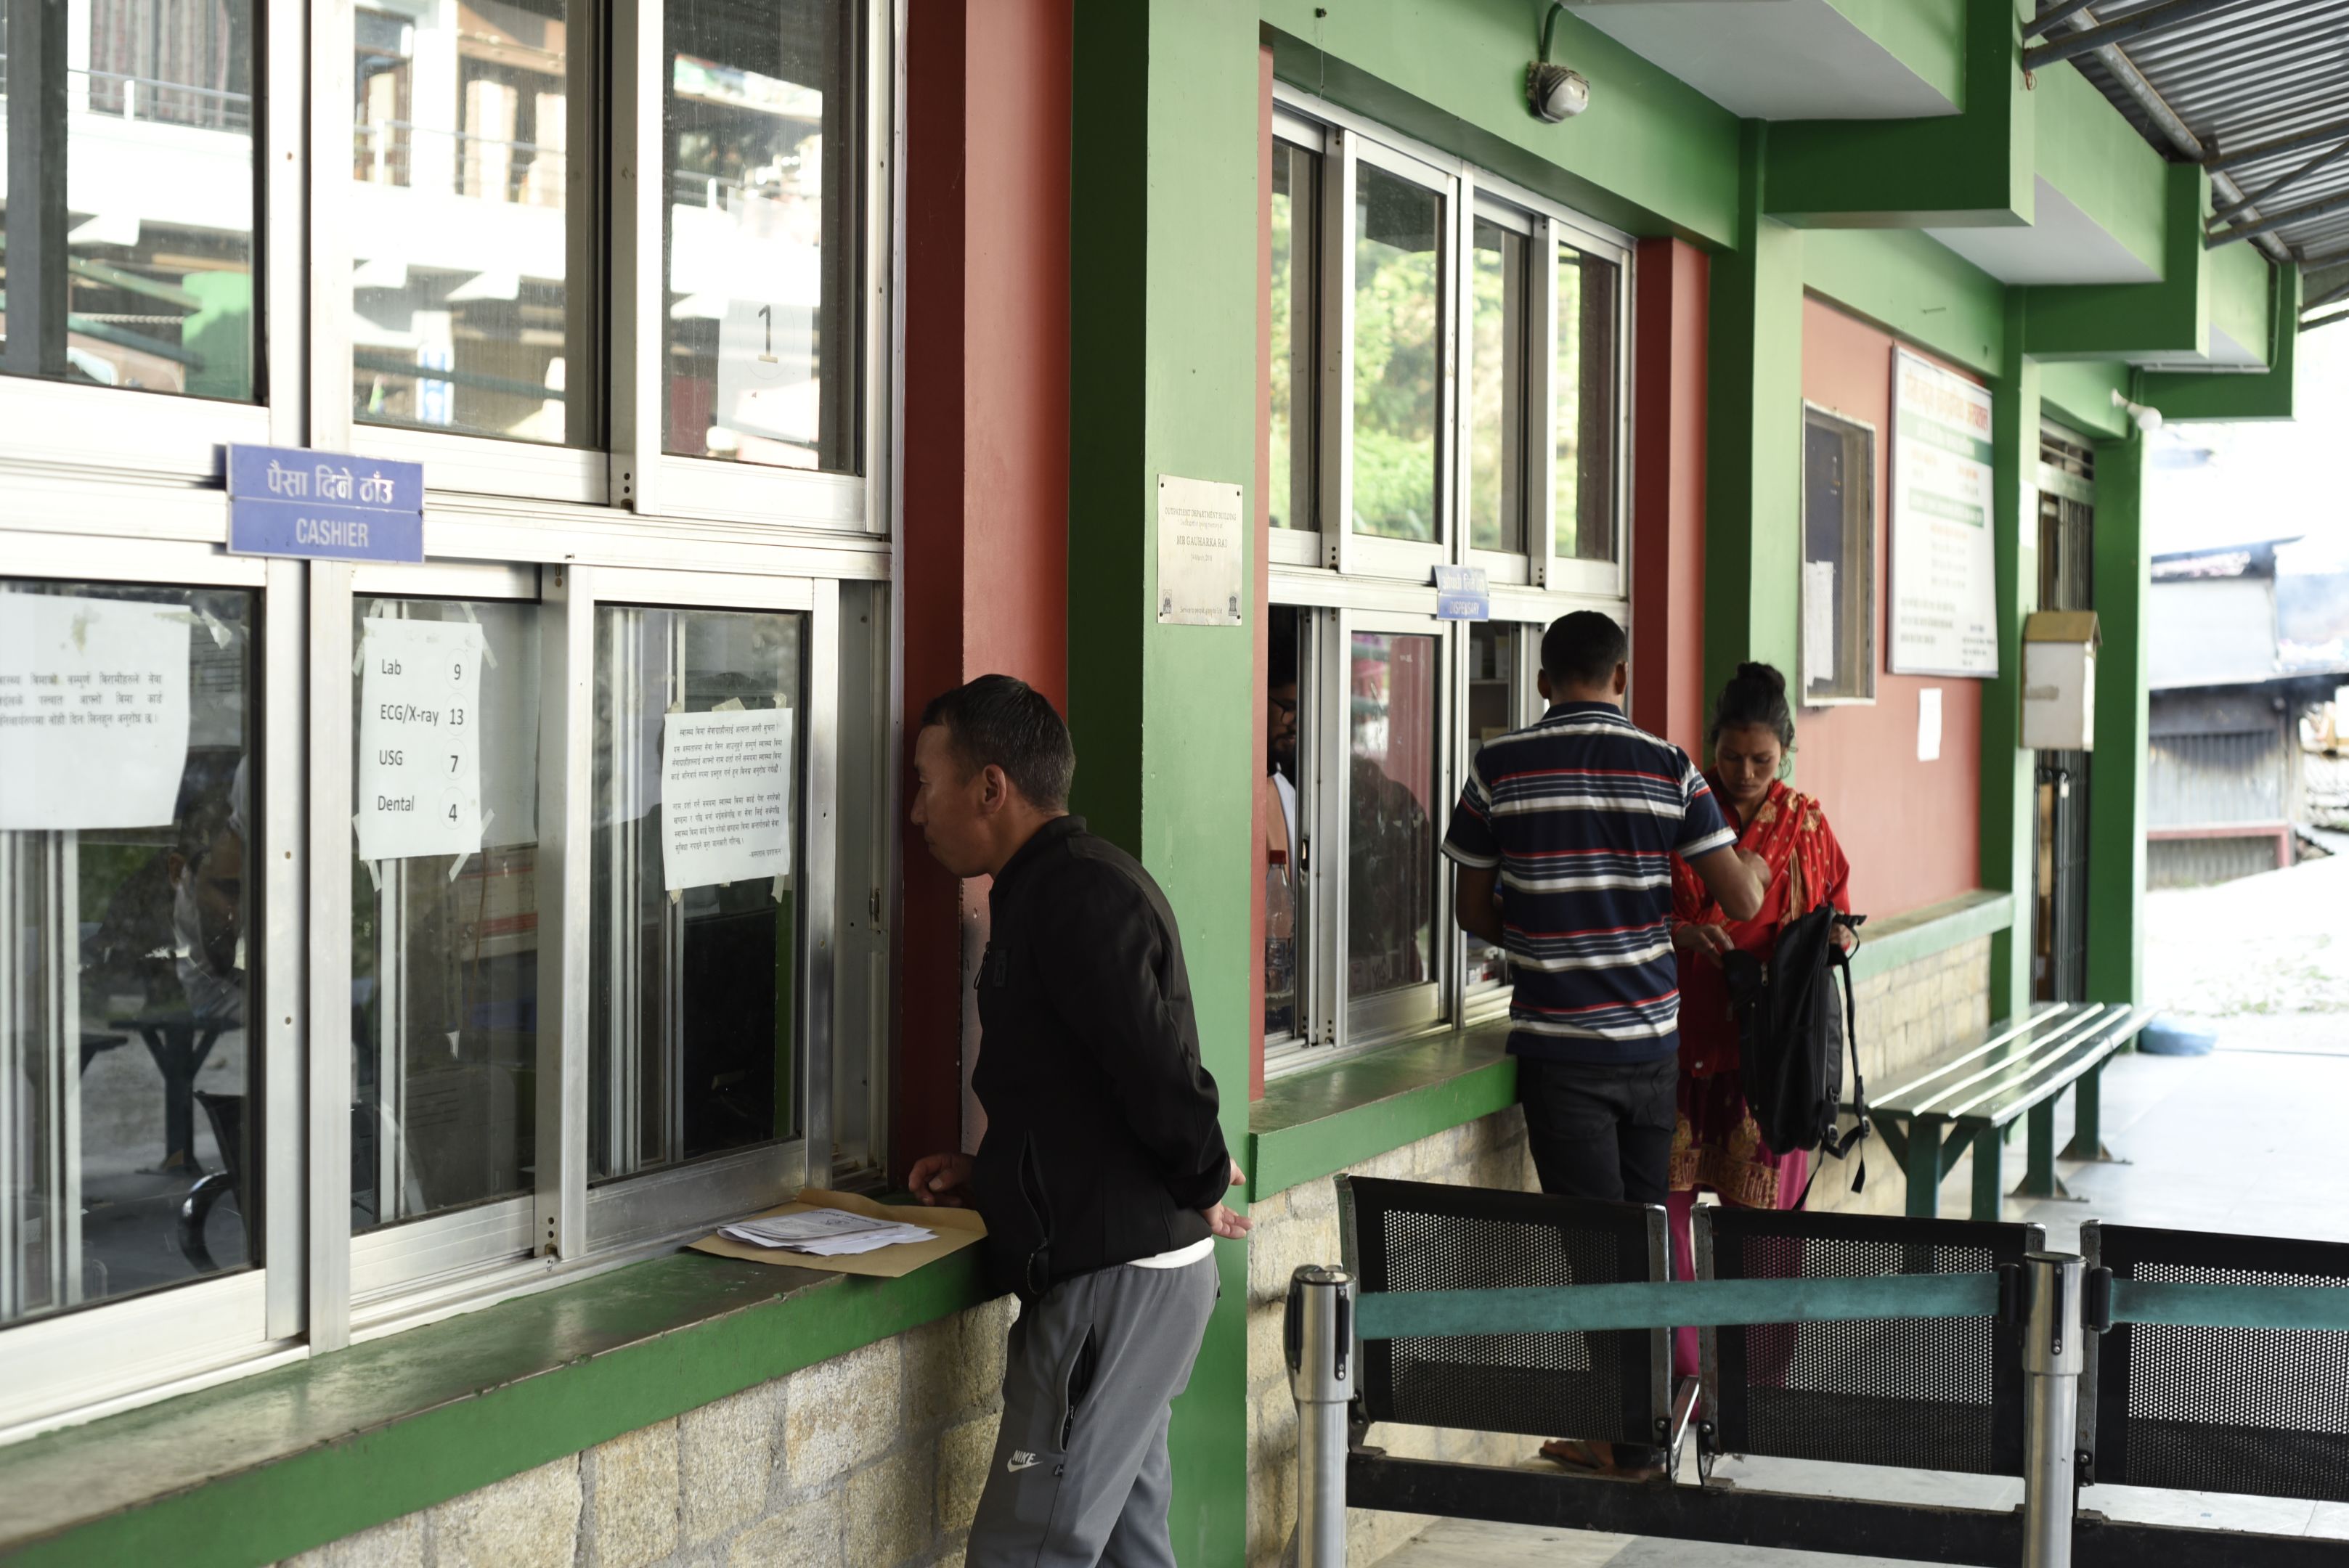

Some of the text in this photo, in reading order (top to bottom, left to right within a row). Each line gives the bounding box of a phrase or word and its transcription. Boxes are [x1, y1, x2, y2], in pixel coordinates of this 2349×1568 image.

[757, 305, 778, 364] 1
[266, 460, 308, 497] पैसा
[315, 465, 354, 500] दिने
[296, 518, 369, 548] CASHIER
[1449, 601, 1480, 616] DISPENSARY
[381, 658, 461, 680] Lab 9
[380, 704, 464, 726] ECG/X-ray 13
[379, 750, 459, 772] USG 7
[378, 795, 457, 822] Dental 4
[1012, 1450, 1036, 1465] NIKE
